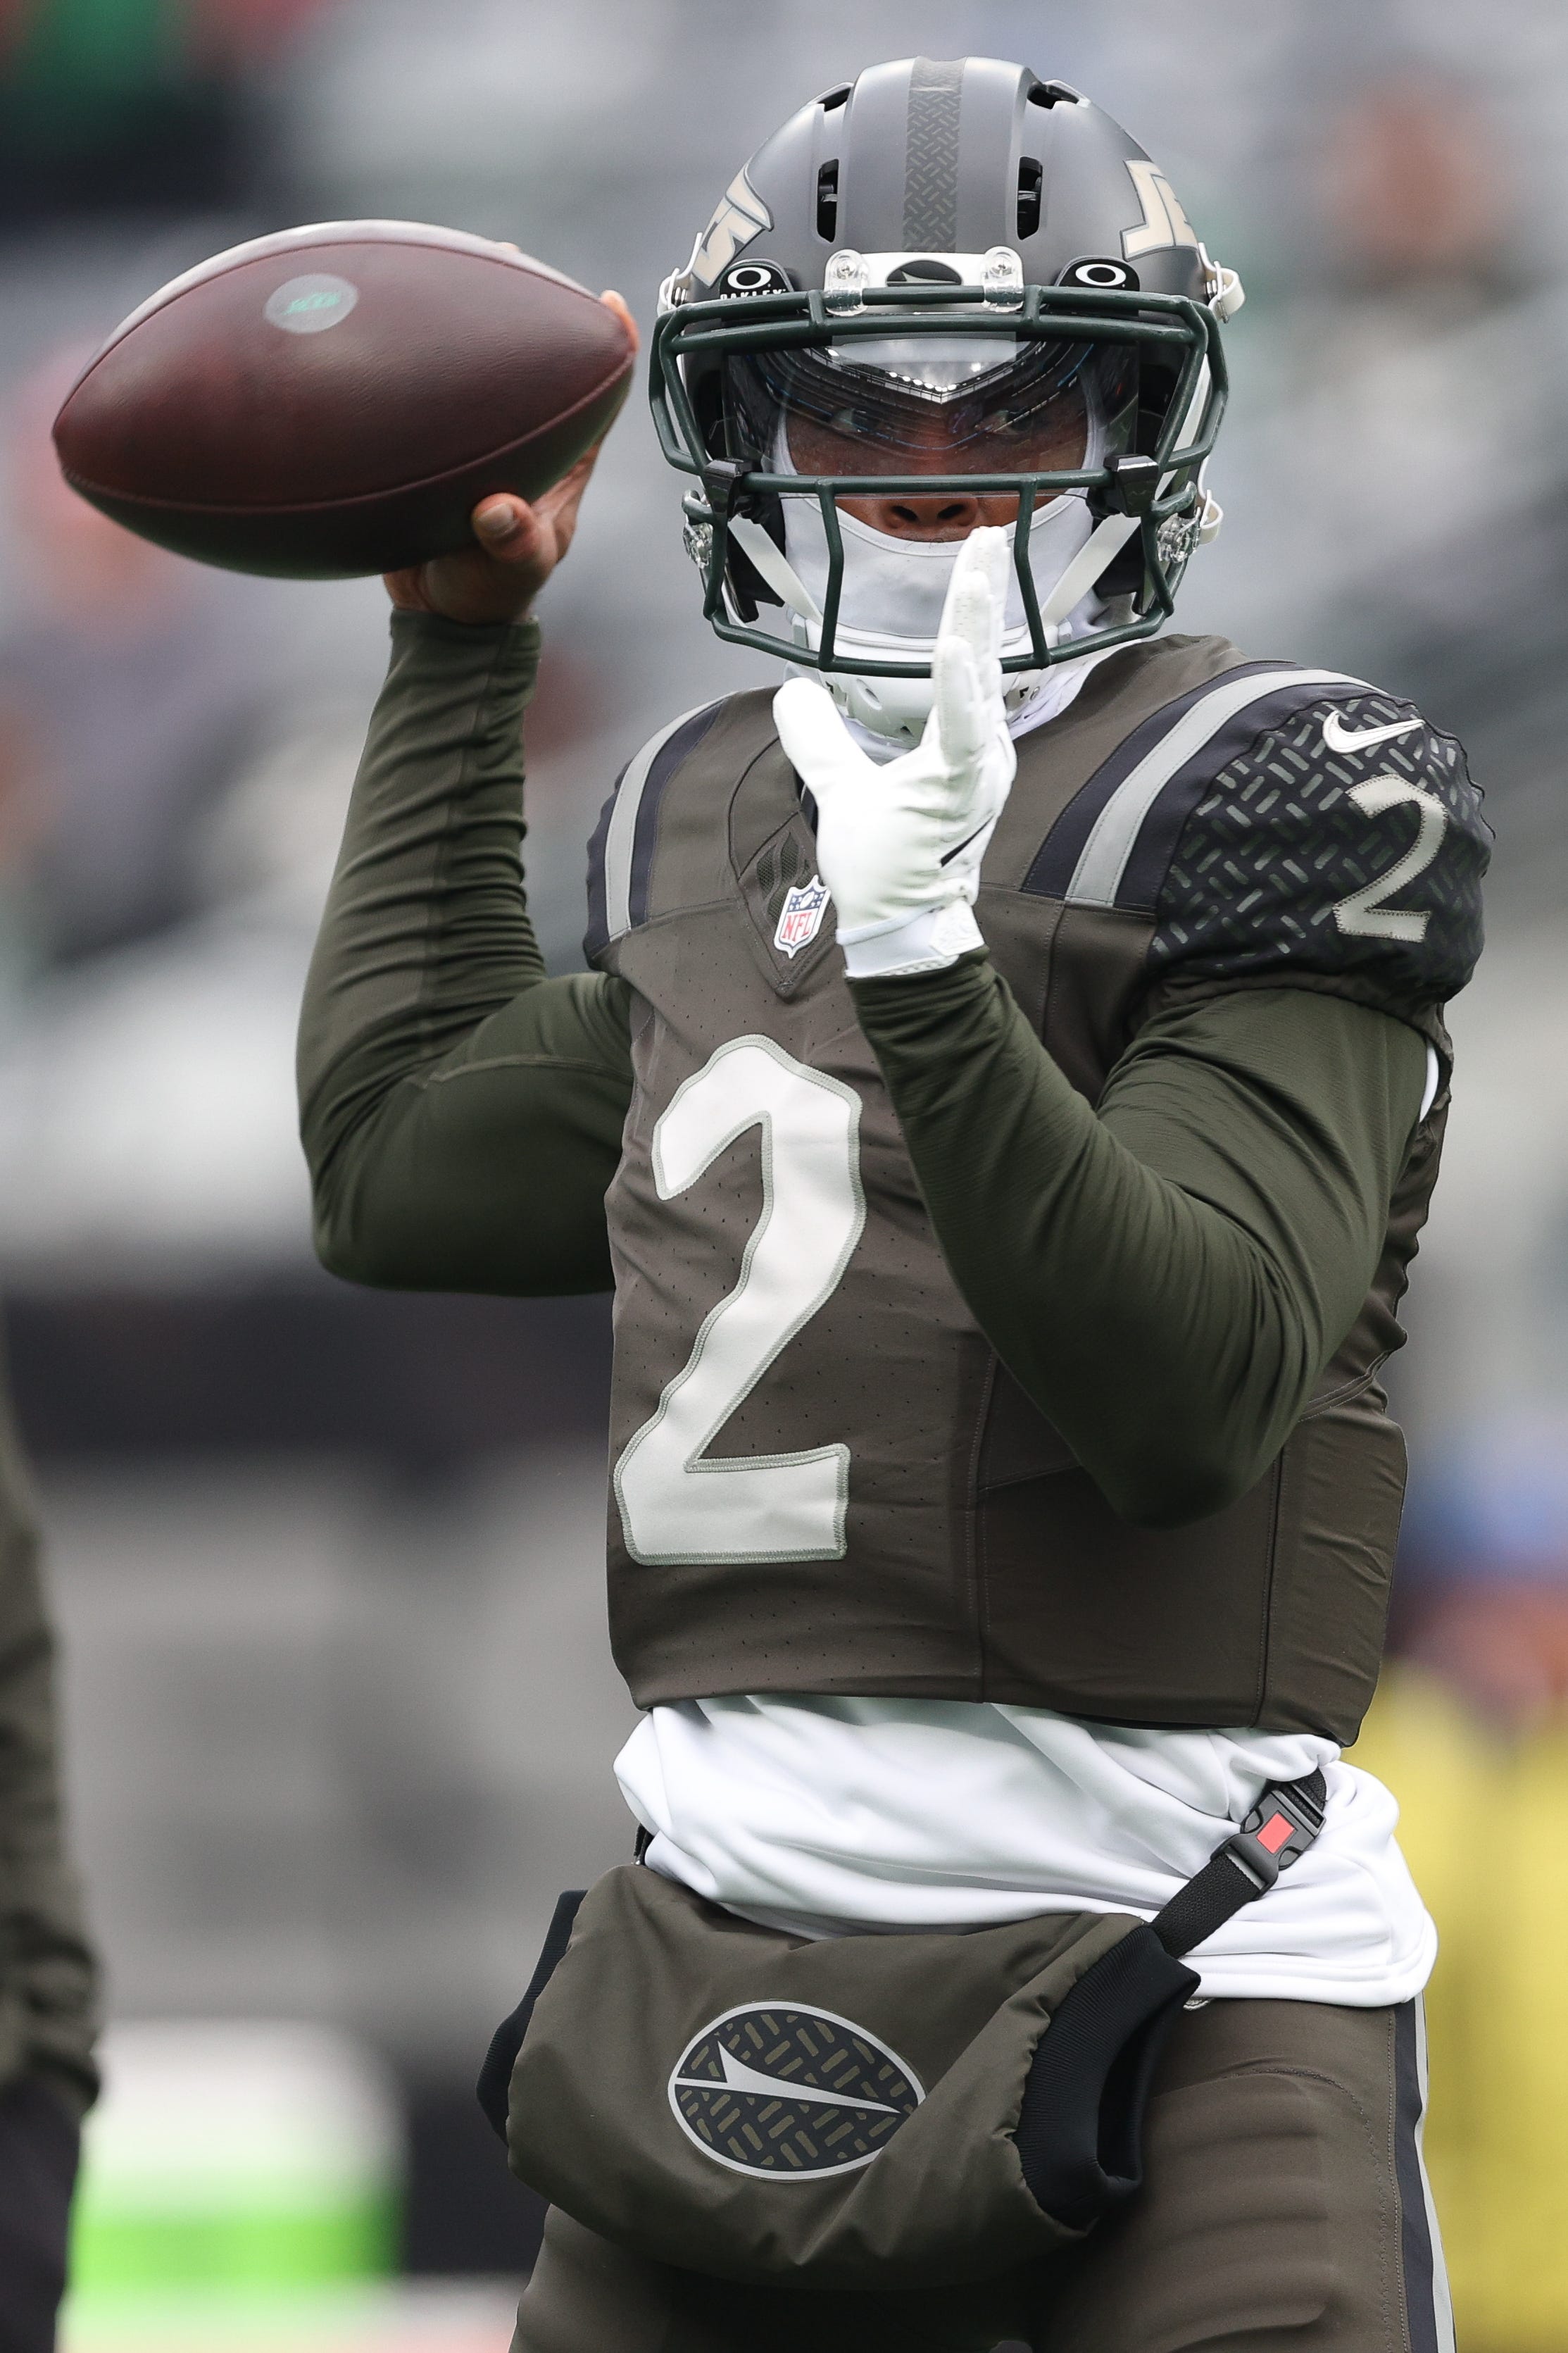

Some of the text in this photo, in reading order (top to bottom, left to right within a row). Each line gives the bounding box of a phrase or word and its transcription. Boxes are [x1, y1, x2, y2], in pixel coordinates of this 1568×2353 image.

[782, 911, 813, 942] NFL
[1333, 773, 1449, 944] 2
[613, 1033, 867, 1566] 2
